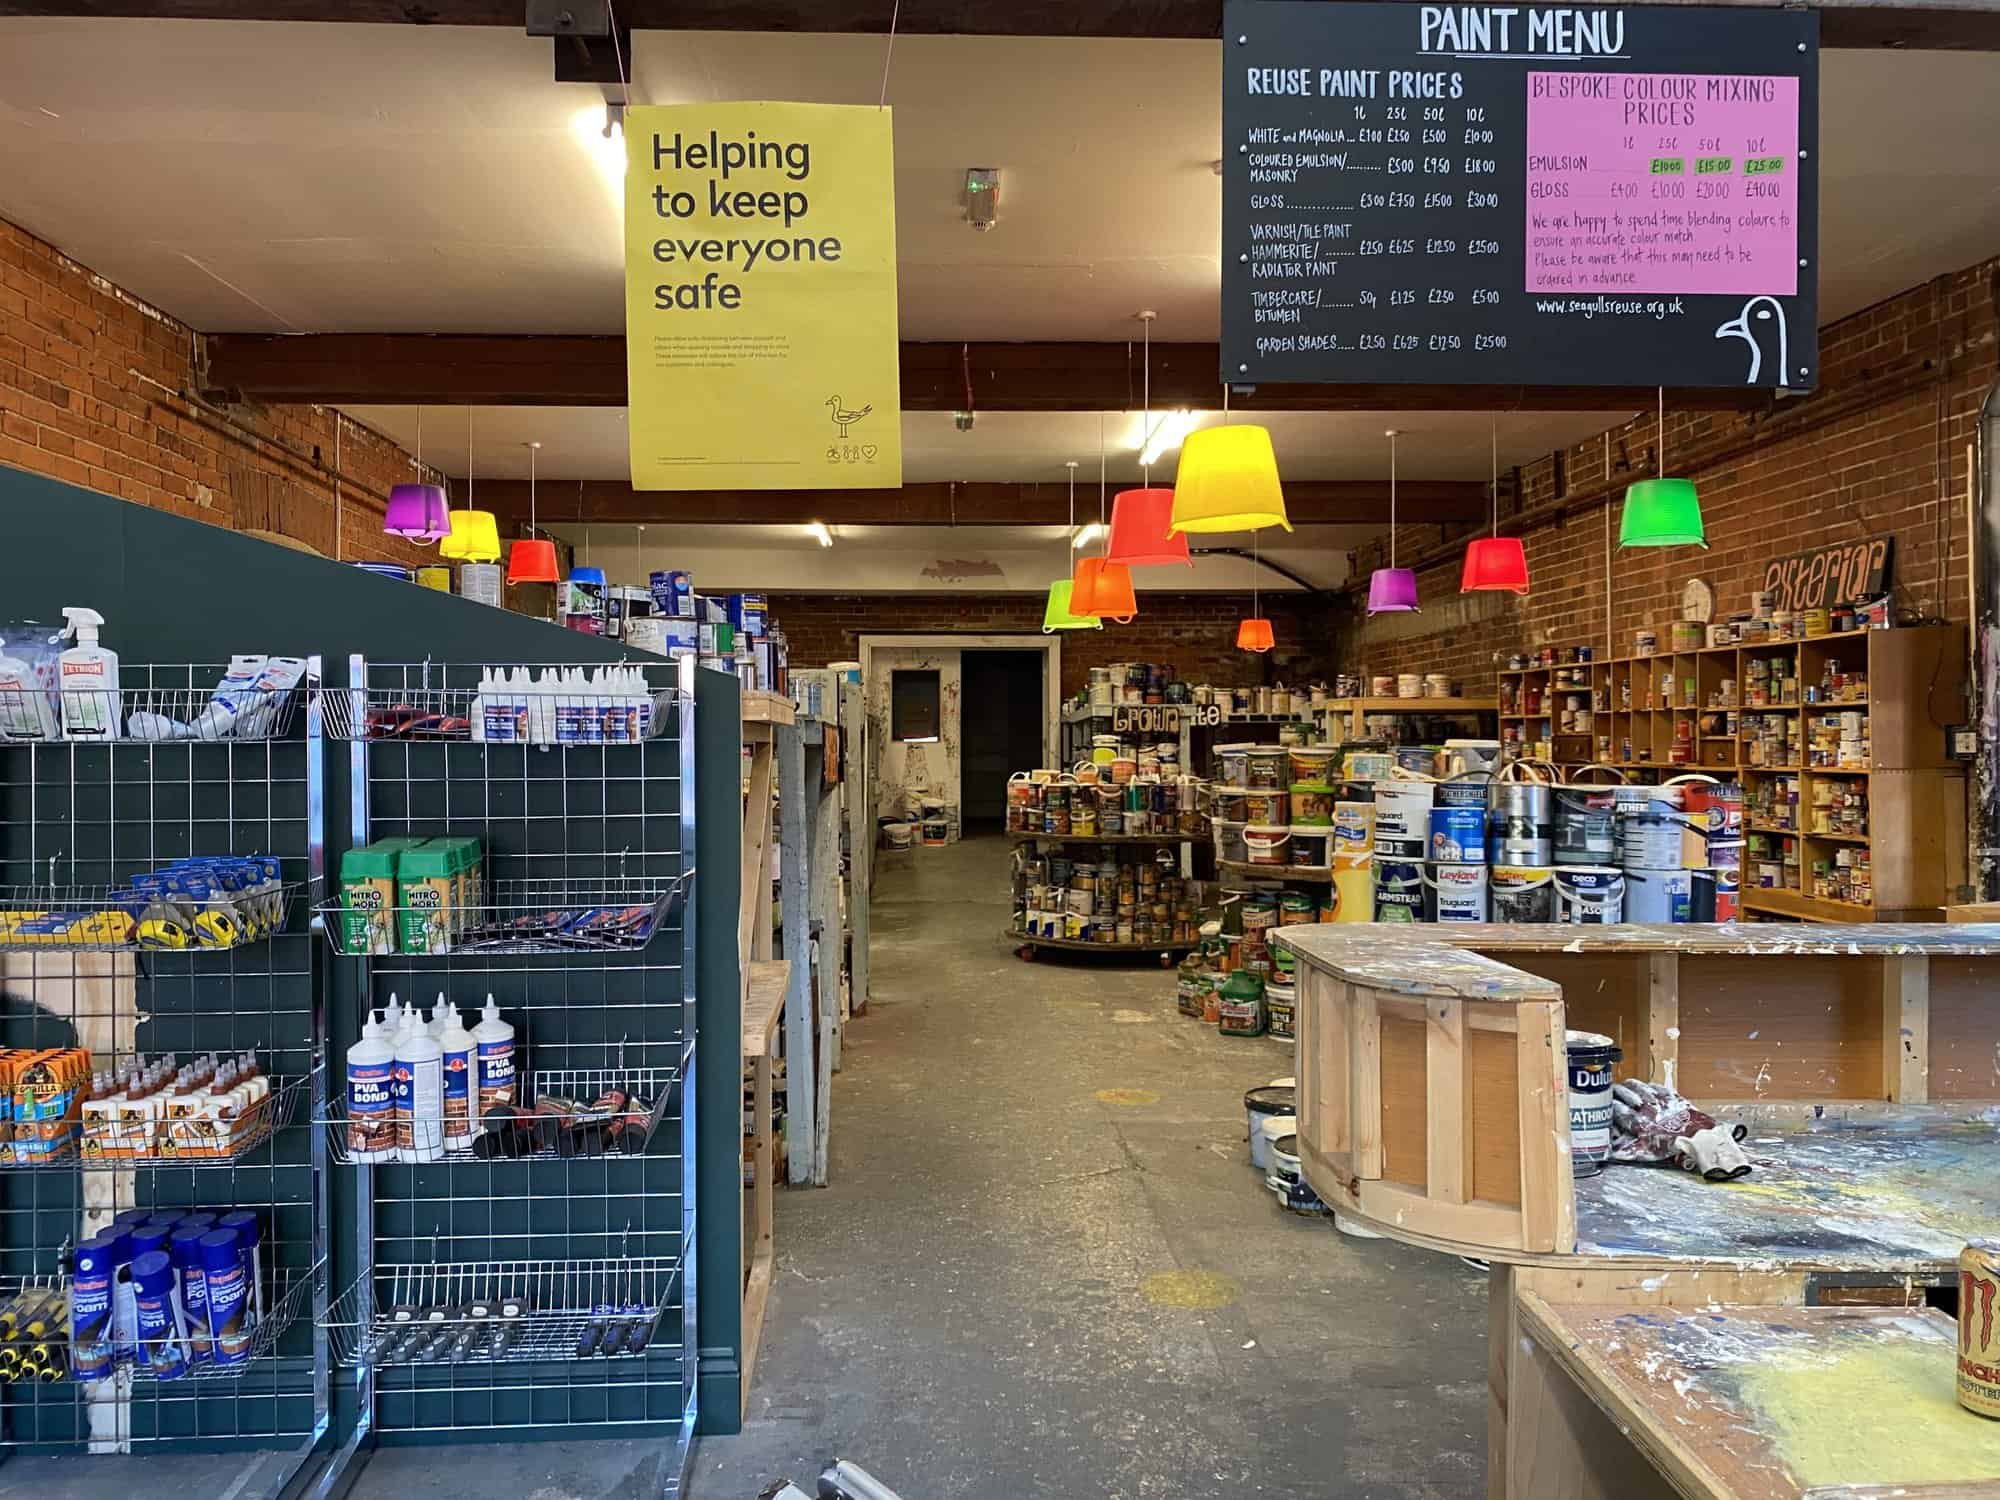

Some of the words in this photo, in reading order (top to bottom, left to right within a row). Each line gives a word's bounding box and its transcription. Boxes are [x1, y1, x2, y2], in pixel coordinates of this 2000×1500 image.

[1420, 7, 1518, 51] PAINT
[1528, 9, 1624, 54] MENU
[1248, 68, 1311, 96] REUSE
[1320, 70, 1380, 98] PAINT
[1389, 71, 1463, 99] PRICES
[1532, 76, 1617, 99] BESPOKE
[1624, 77, 1697, 100] COLOUR
[1707, 79, 1775, 102] MIXING
[1624, 102, 1696, 126] PRICES
[1248, 128, 1280, 143] WHITE
[1283, 132, 1296, 142] and
[653, 131, 810, 181] Helping
[1249, 153, 1293, 168] COLOURED
[1529, 155, 1588, 171] EMULSION
[1250, 169, 1298, 183] MASONRY
[1531, 182, 1569, 198] GLOSS
[652, 184, 696, 218] to
[709, 179, 809, 229] keep
[1251, 194, 1284, 208] GLOSS
[1532, 210, 1547, 229] We
[1553, 215, 1568, 230] are
[1574, 209, 1606, 233] happy
[1614, 210, 1623, 225] to
[1628, 211, 1657, 232] spend
[1662, 209, 1684, 225] time
[1687, 211, 1731, 233] blending
[1780, 210, 1790, 226] to
[1323, 224, 1352, 240] PAINT
[653, 237, 842, 272] everyone
[1535, 252, 1567, 268] Please
[1696, 246, 1720, 263] need
[1252, 262, 1303, 279] RADIATOR
[1306, 261, 1338, 277] PAINT
[654, 272, 742, 310] safe
[1255, 308, 1300, 324] BITUMEN
[1536, 296, 1684, 320] www.seagullsreuse.org.uk
[1256, 335, 1295, 358] GARDEN
[1764, 540, 1886, 612] exterior
[1440, 869, 1479, 880] Leyland
[351, 890, 382, 901] NITRO
[409, 890, 440, 901] NITRO
[1440, 897, 1476, 908] Truguard
[353, 900, 379, 909] MORS
[411, 900, 437, 908] MORS
[487, 1058, 510, 1070] PVA
[1576, 1070, 1612, 1087] Dulu
[354, 1083, 380, 1093] PVA
[354, 1091, 390, 1103] BOND
[1569, 1108, 1611, 1123] ATHROO
[73, 1302, 108, 1313] oam
